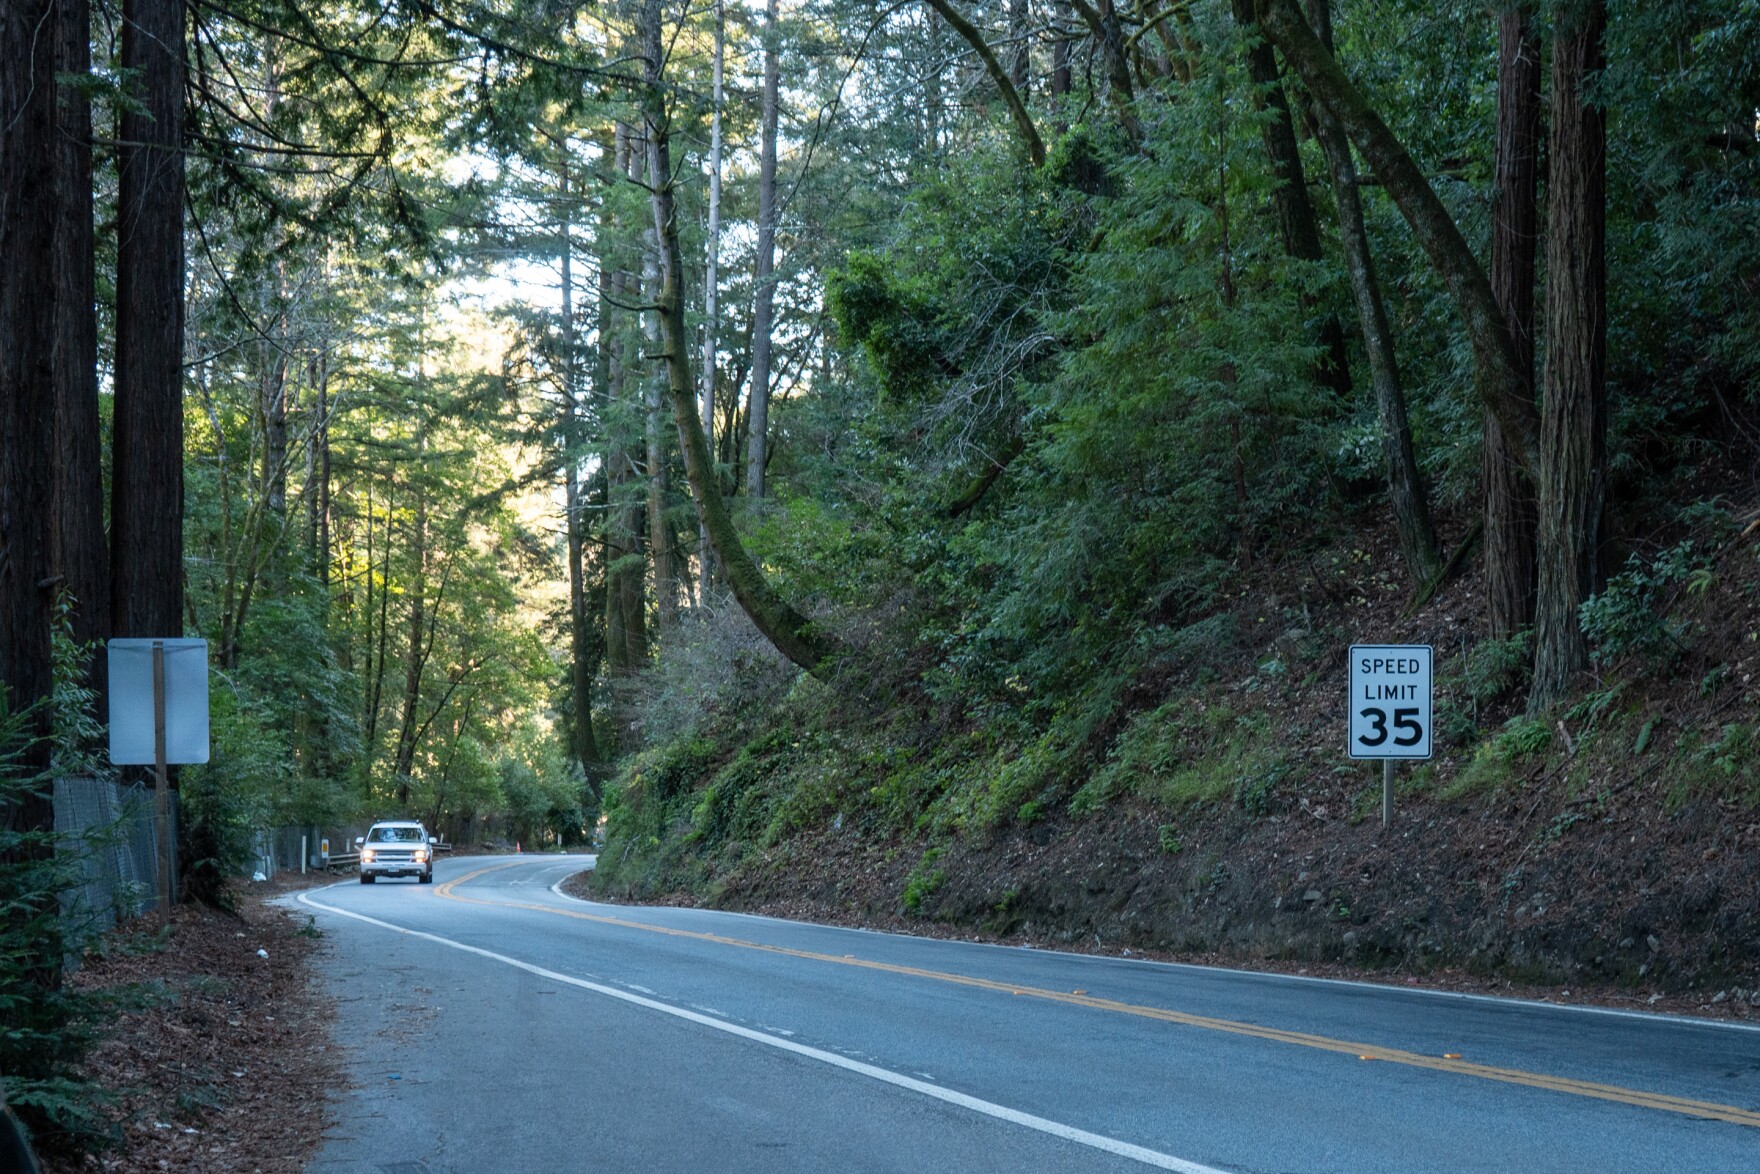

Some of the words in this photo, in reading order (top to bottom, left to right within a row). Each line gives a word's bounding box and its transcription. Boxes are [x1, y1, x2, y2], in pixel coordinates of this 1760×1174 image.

[1361, 659, 1420, 674] SPEED
[1365, 685, 1417, 700] LIMIT
[1358, 707, 1423, 747] 35
